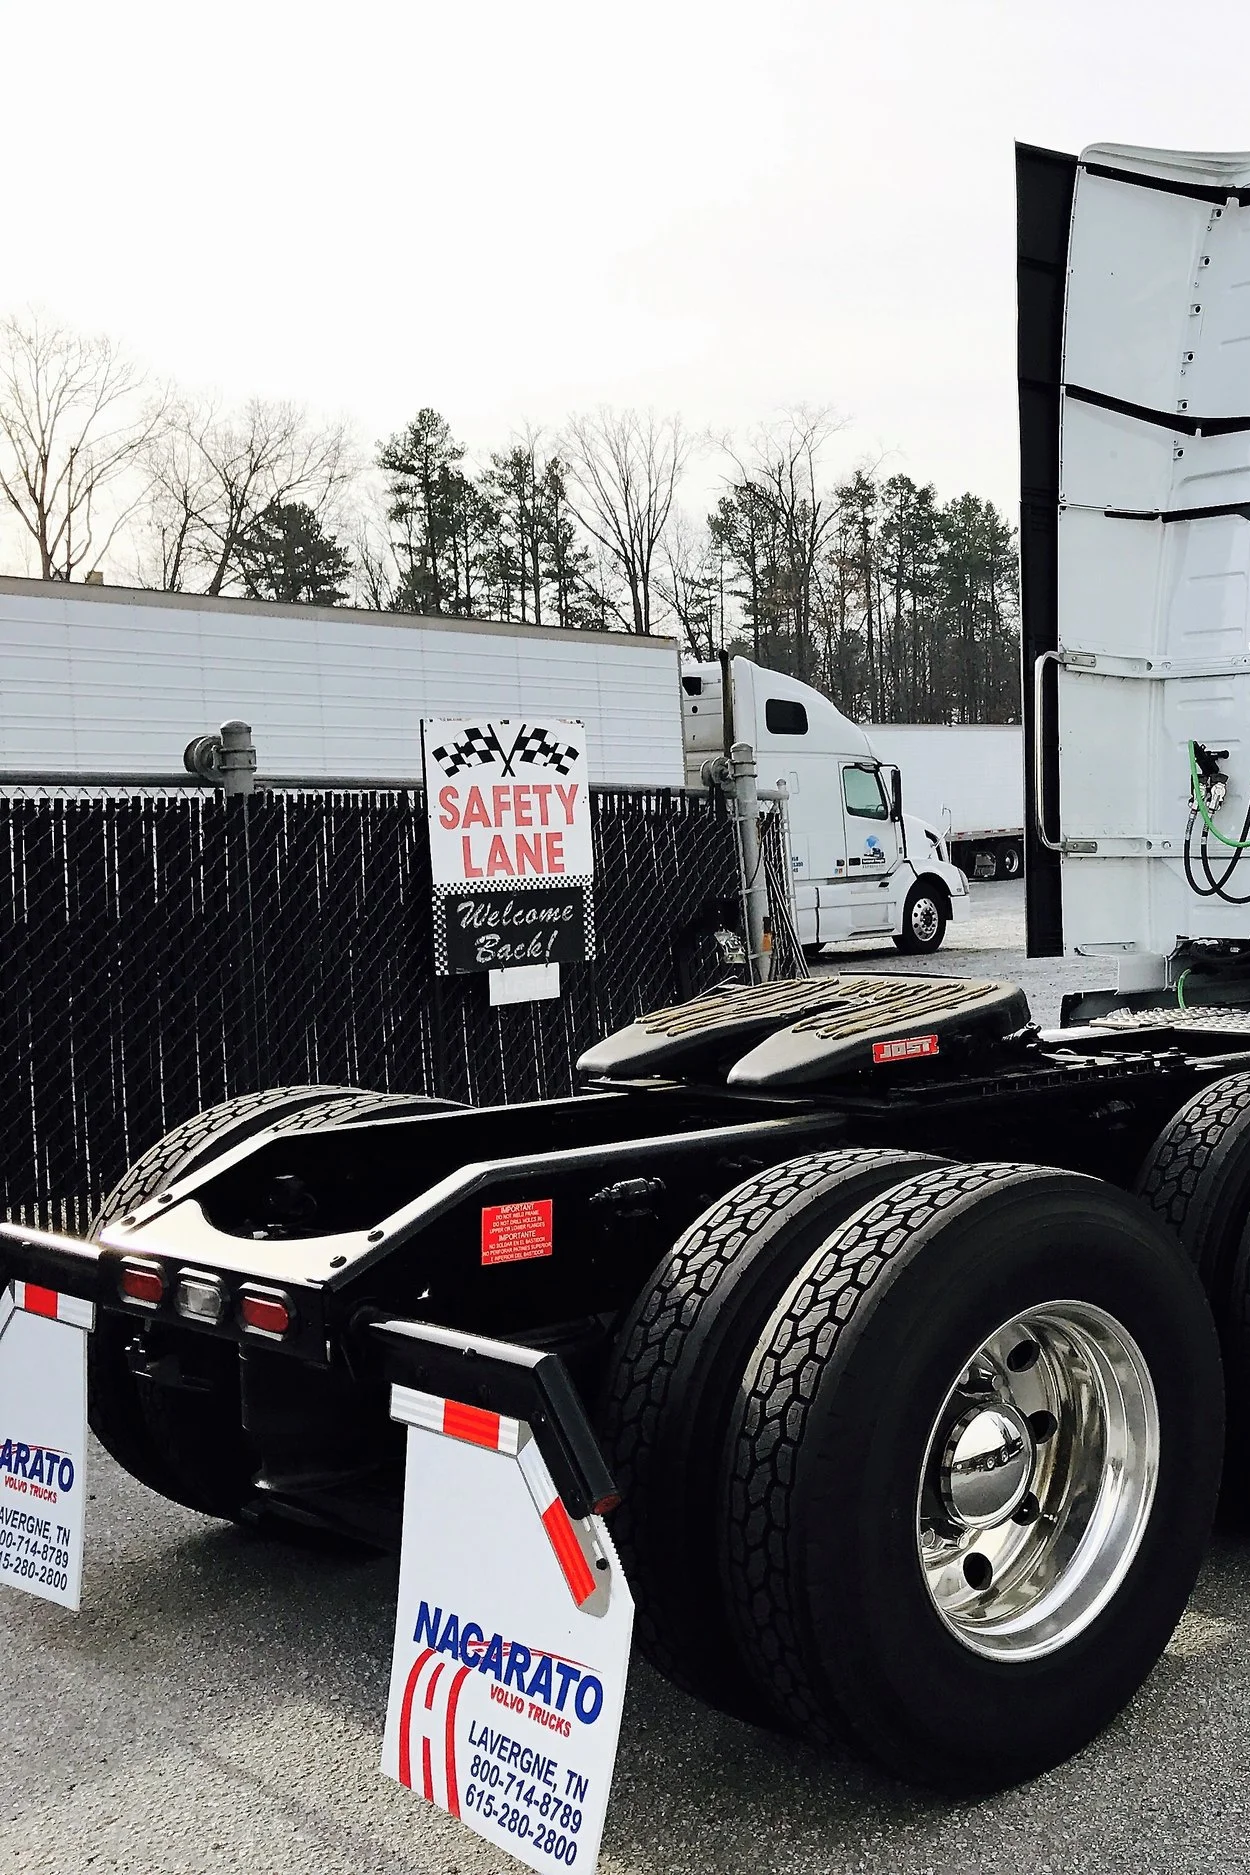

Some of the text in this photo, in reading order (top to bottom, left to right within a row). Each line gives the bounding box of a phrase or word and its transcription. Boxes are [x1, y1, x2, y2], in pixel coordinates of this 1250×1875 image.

[438, 783, 579, 830] SAFETY
[461, 831, 565, 879] LANE
[456, 900, 574, 929] Welcome
[474, 930, 559, 963] Back!
[880, 1038, 932, 1059] JOST
[501, 1202, 534, 1213] IMPORTANT
[498, 1230, 536, 1242] IMPORTANTE
[0, 1438, 75, 1493] ARATO
[4, 1475, 58, 1504] VOLVO TRUCKS
[0, 1529, 69, 1569] 00-714-8789
[57, 1525, 71, 1547] TN
[413, 1600, 604, 1725] NACARATO
[490, 1683, 572, 1738] VOLVO TRUCKS
[468, 1720, 589, 1804] LAVERGNE, TN
[470, 1754, 583, 1834] 800-714-8789
[465, 1783, 578, 1866] 615-280-2800
